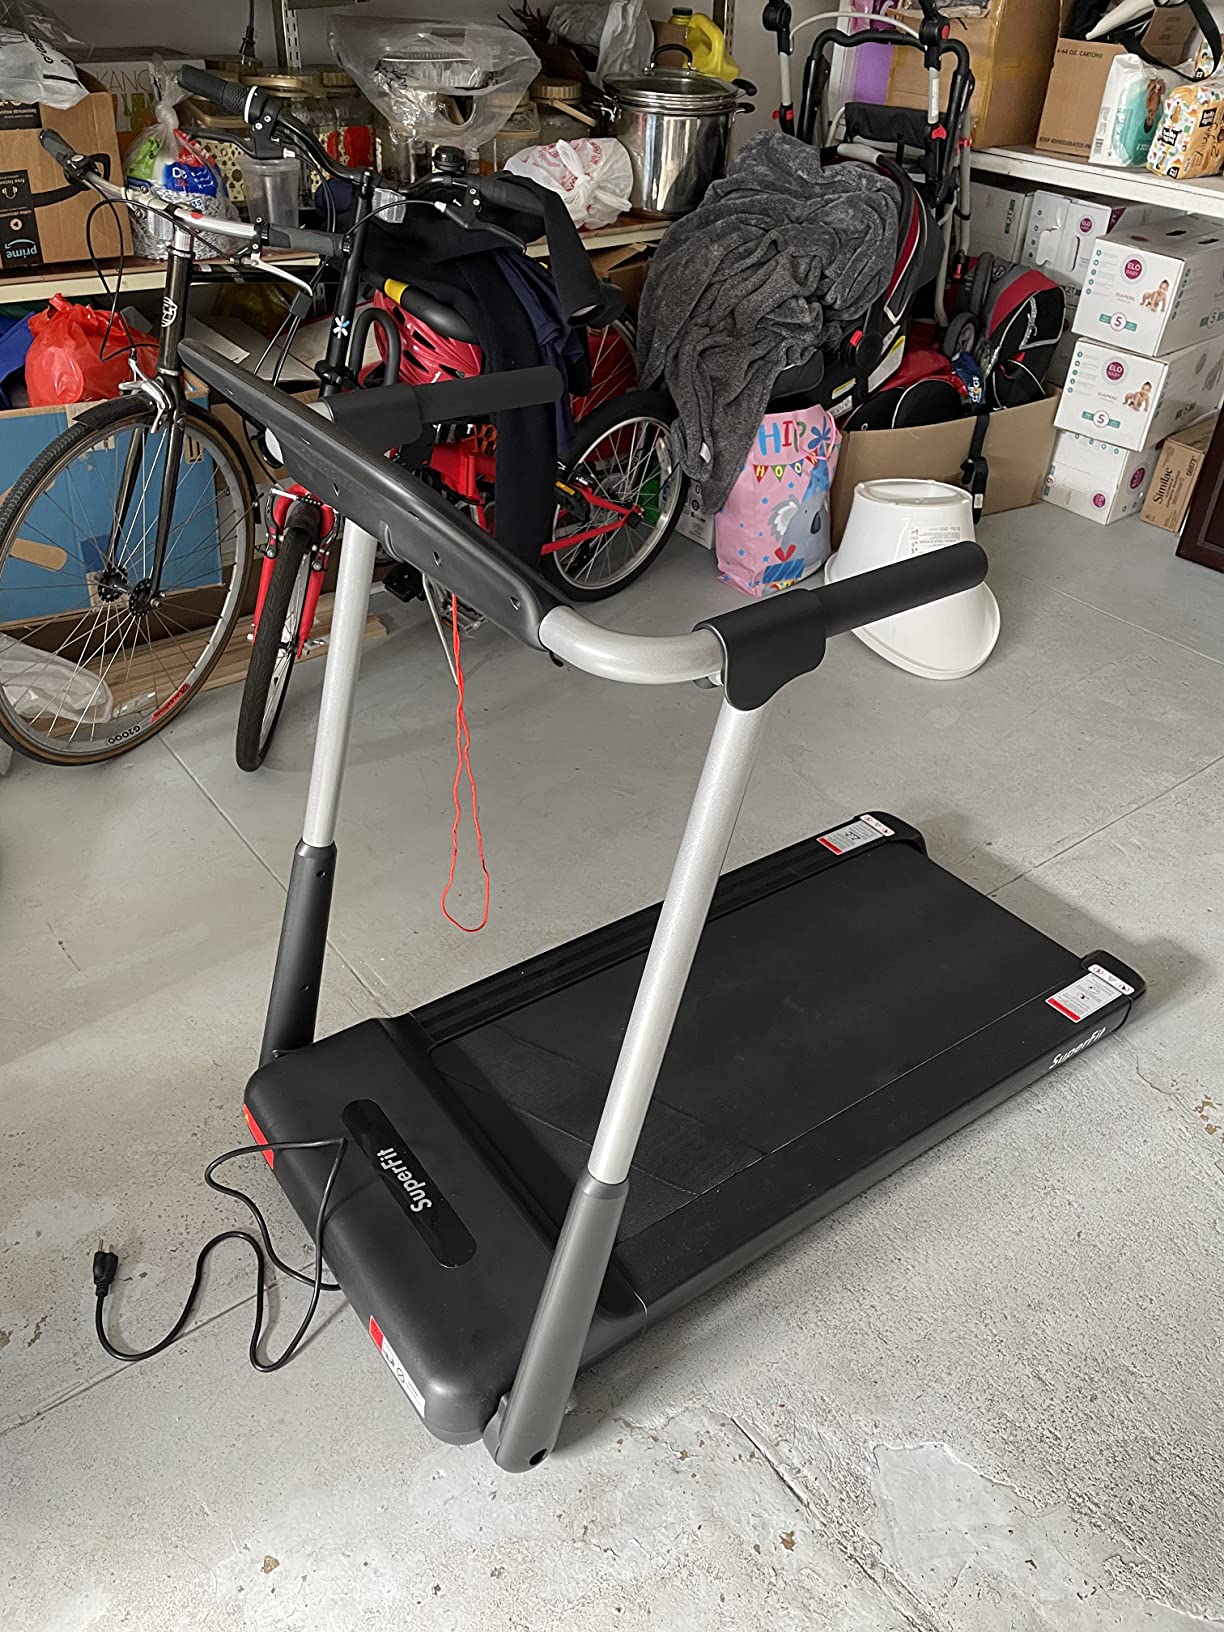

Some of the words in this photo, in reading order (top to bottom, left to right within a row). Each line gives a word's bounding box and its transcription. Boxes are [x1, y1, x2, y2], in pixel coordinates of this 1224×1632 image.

[6, 244, 38, 259] prime
[1127, 262, 1141, 272] ELO
[1114, 316, 1122, 327] 5
[1108, 364, 1123, 373] ELO
[1097, 414, 1105, 424] 5
[1153, 467, 1173, 504] Similac
[107, 725, 141, 744] G2000
[377, 1147, 433, 1212] SuperFit
